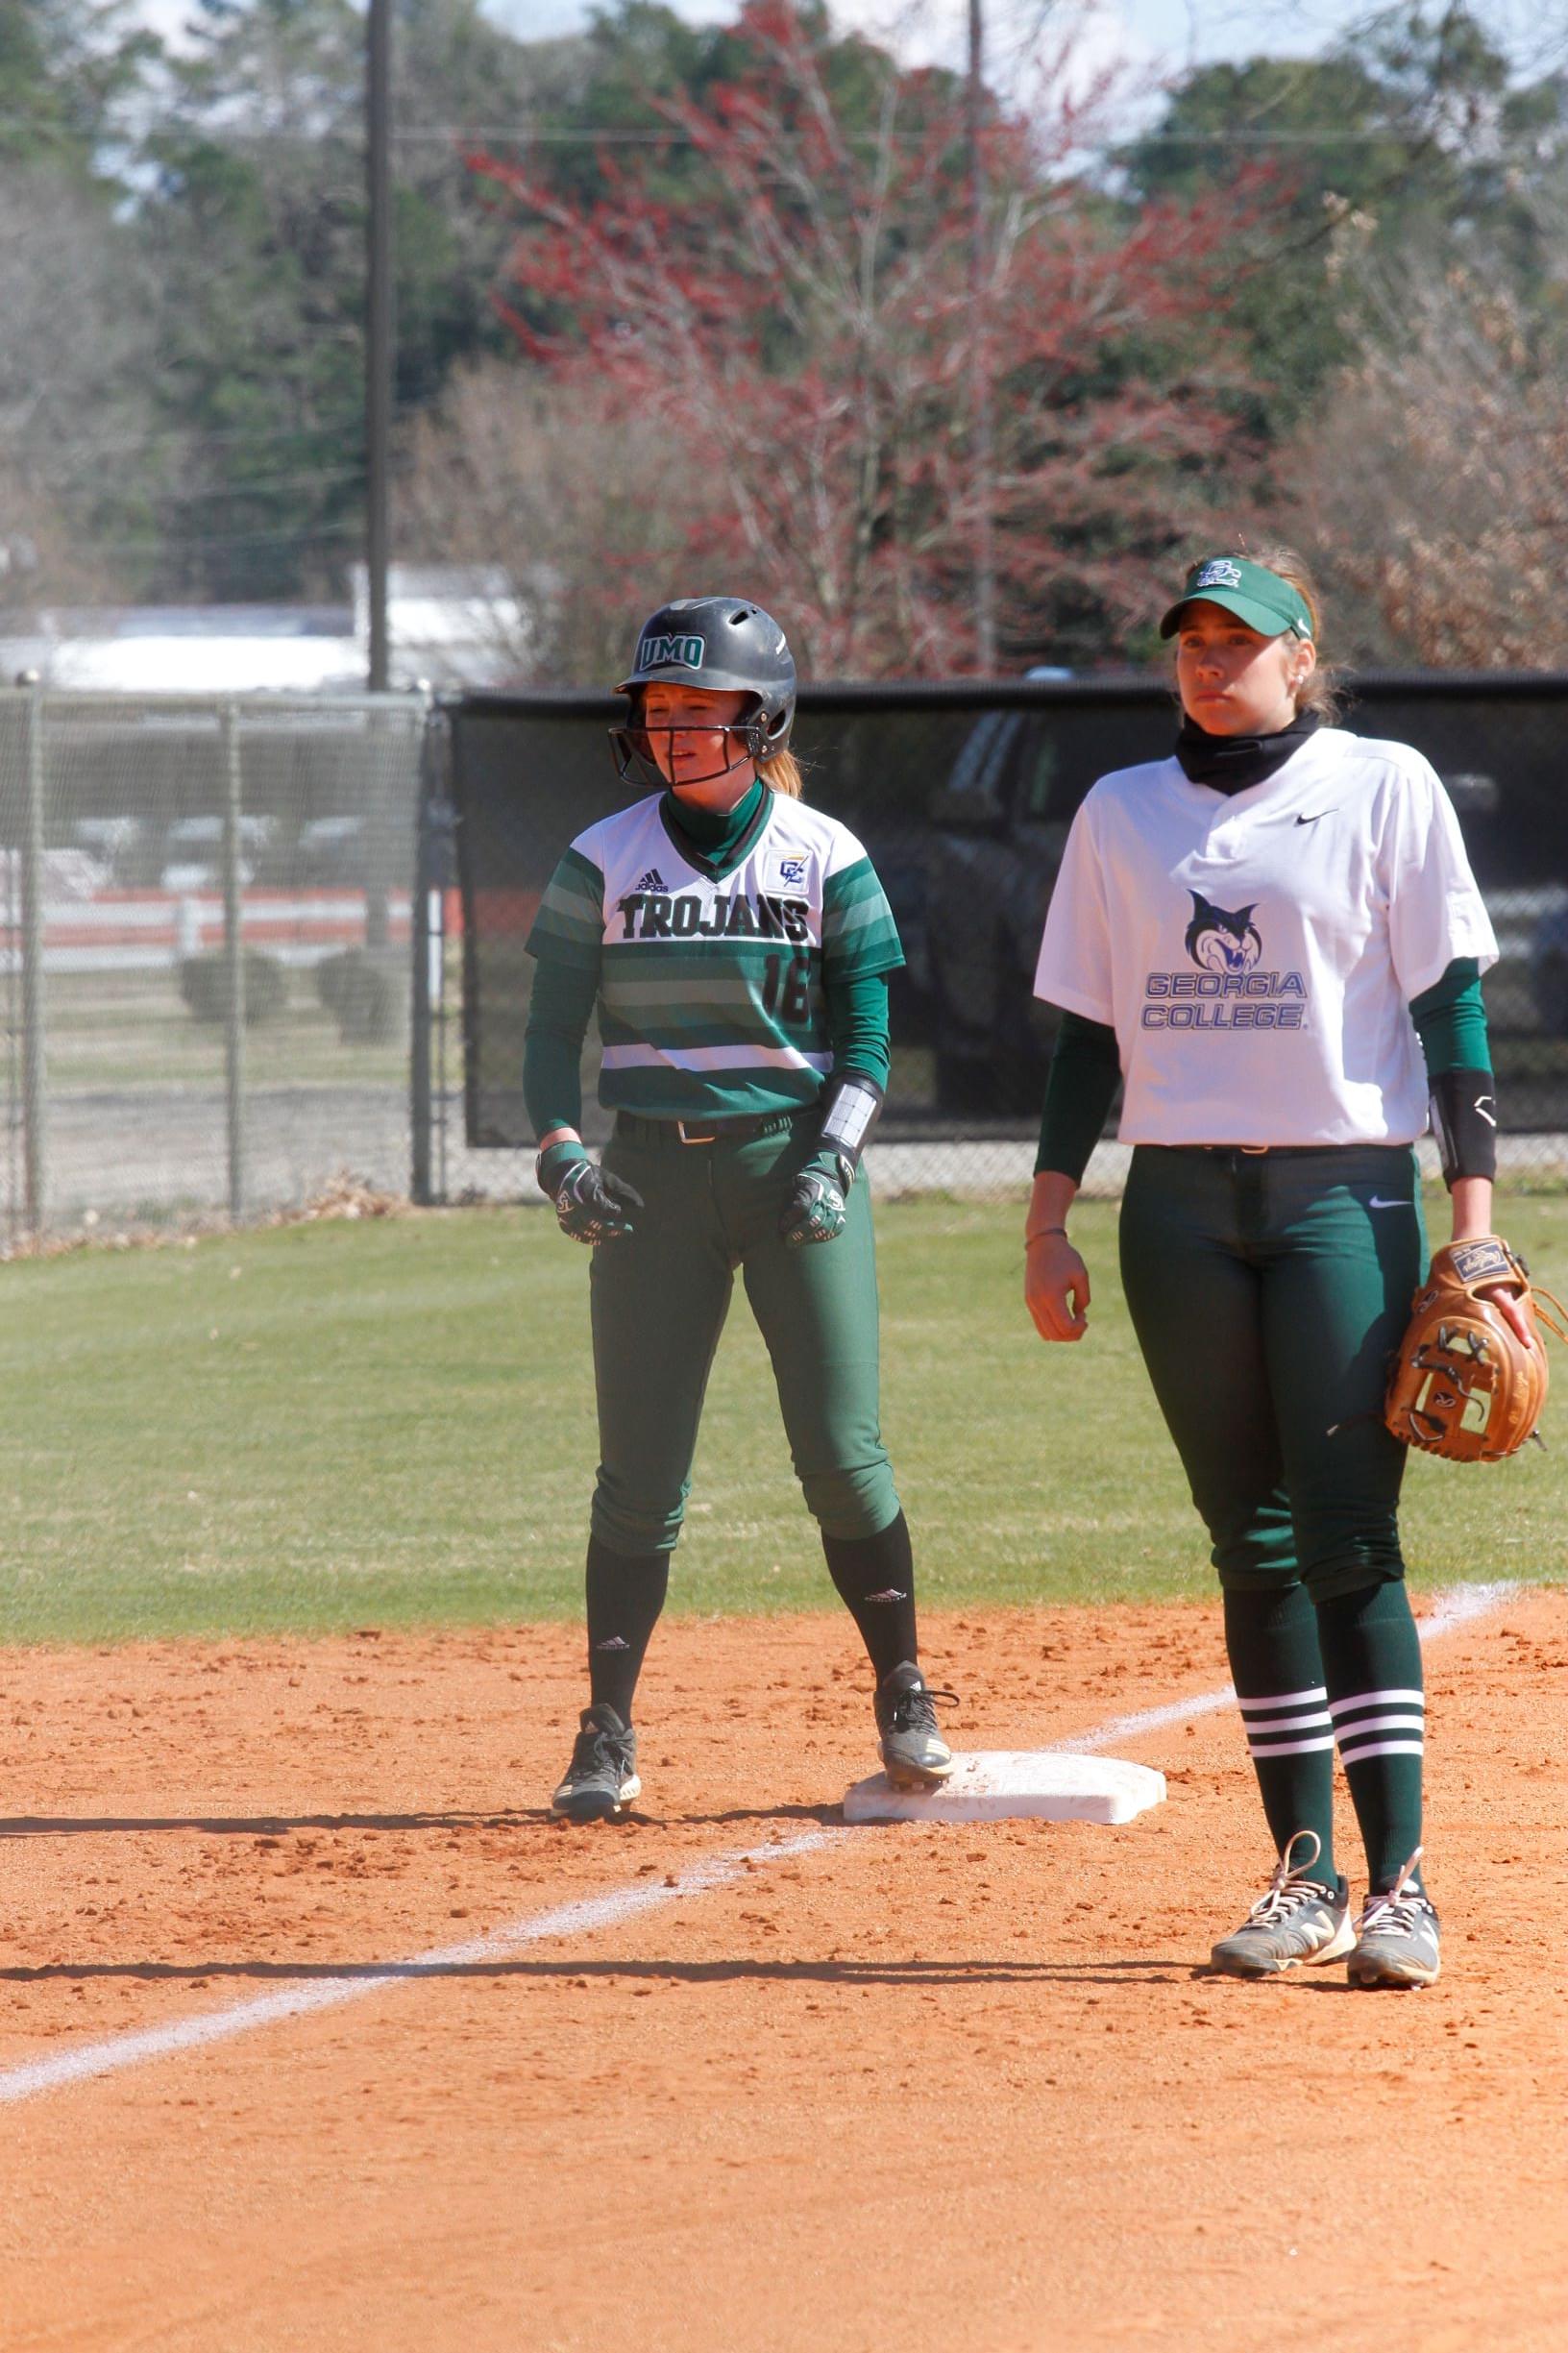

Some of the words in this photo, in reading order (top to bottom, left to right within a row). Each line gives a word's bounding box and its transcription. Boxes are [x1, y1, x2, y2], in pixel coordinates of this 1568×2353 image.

[640, 634, 704, 671] UMO
[617, 894, 810, 942] TROJANS
[1145, 972, 1308, 999] GEORGIA
[1141, 1004, 1305, 1031] COLLEGE
